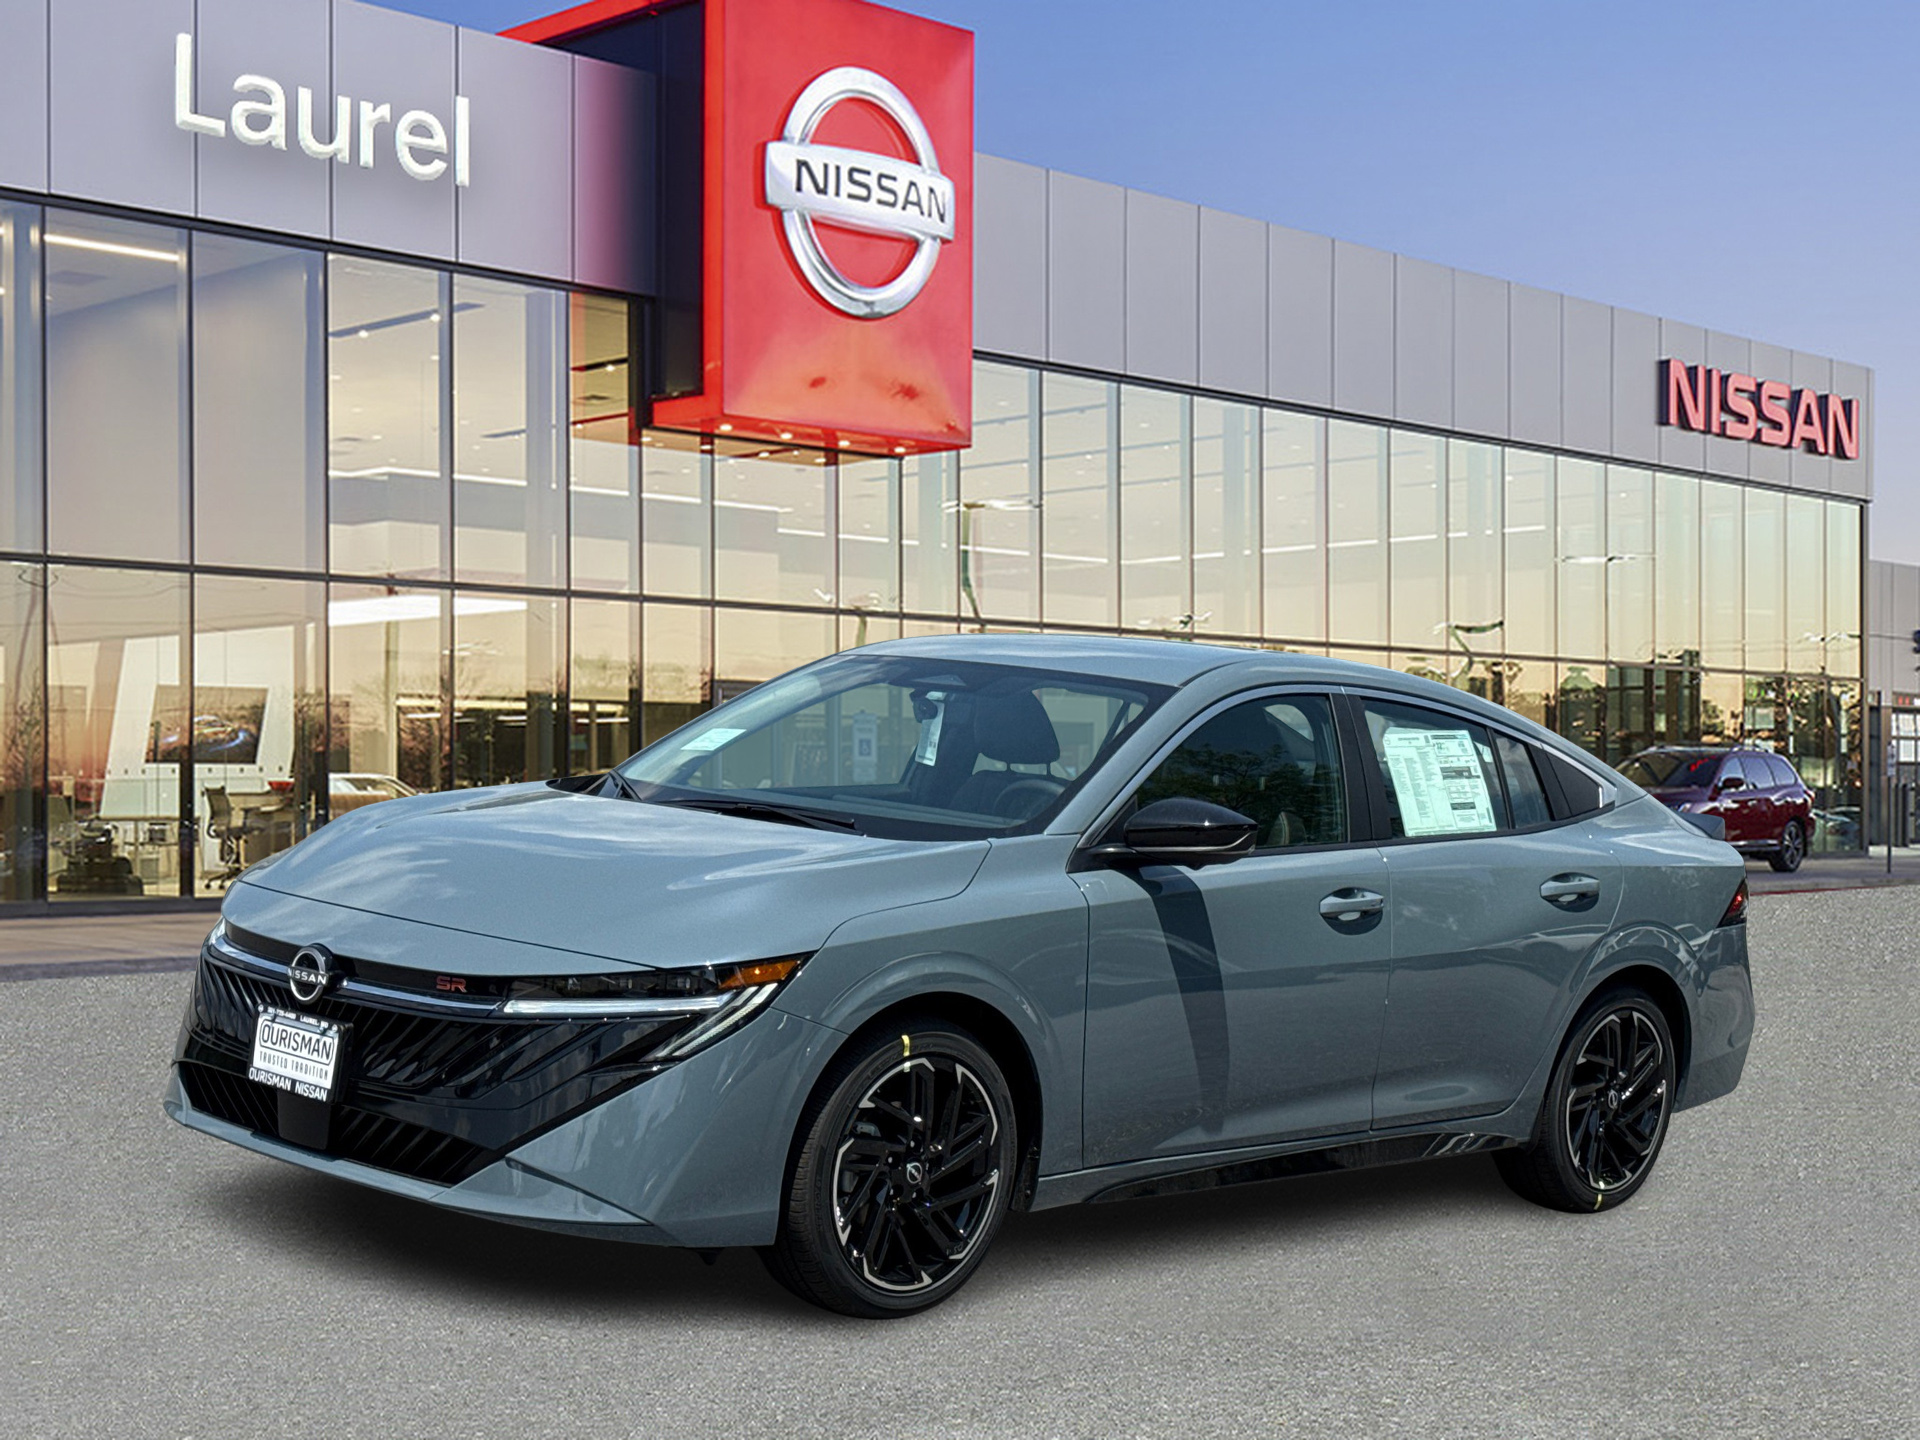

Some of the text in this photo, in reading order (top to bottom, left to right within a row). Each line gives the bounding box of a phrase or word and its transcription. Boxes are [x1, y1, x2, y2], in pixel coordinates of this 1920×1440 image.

[175, 32, 470, 188] Laurel
[795, 158, 947, 224] NISSAN
[1657, 358, 1860, 460] NISSAN
[287, 967, 327, 985] NISSAN
[436, 975, 467, 993] SR
[261, 1023, 332, 1061] OURISMAN
[248, 1066, 328, 1102] OURISMAN NISSAN
[260, 1050, 329, 1081] TRUSTED TRADITION
